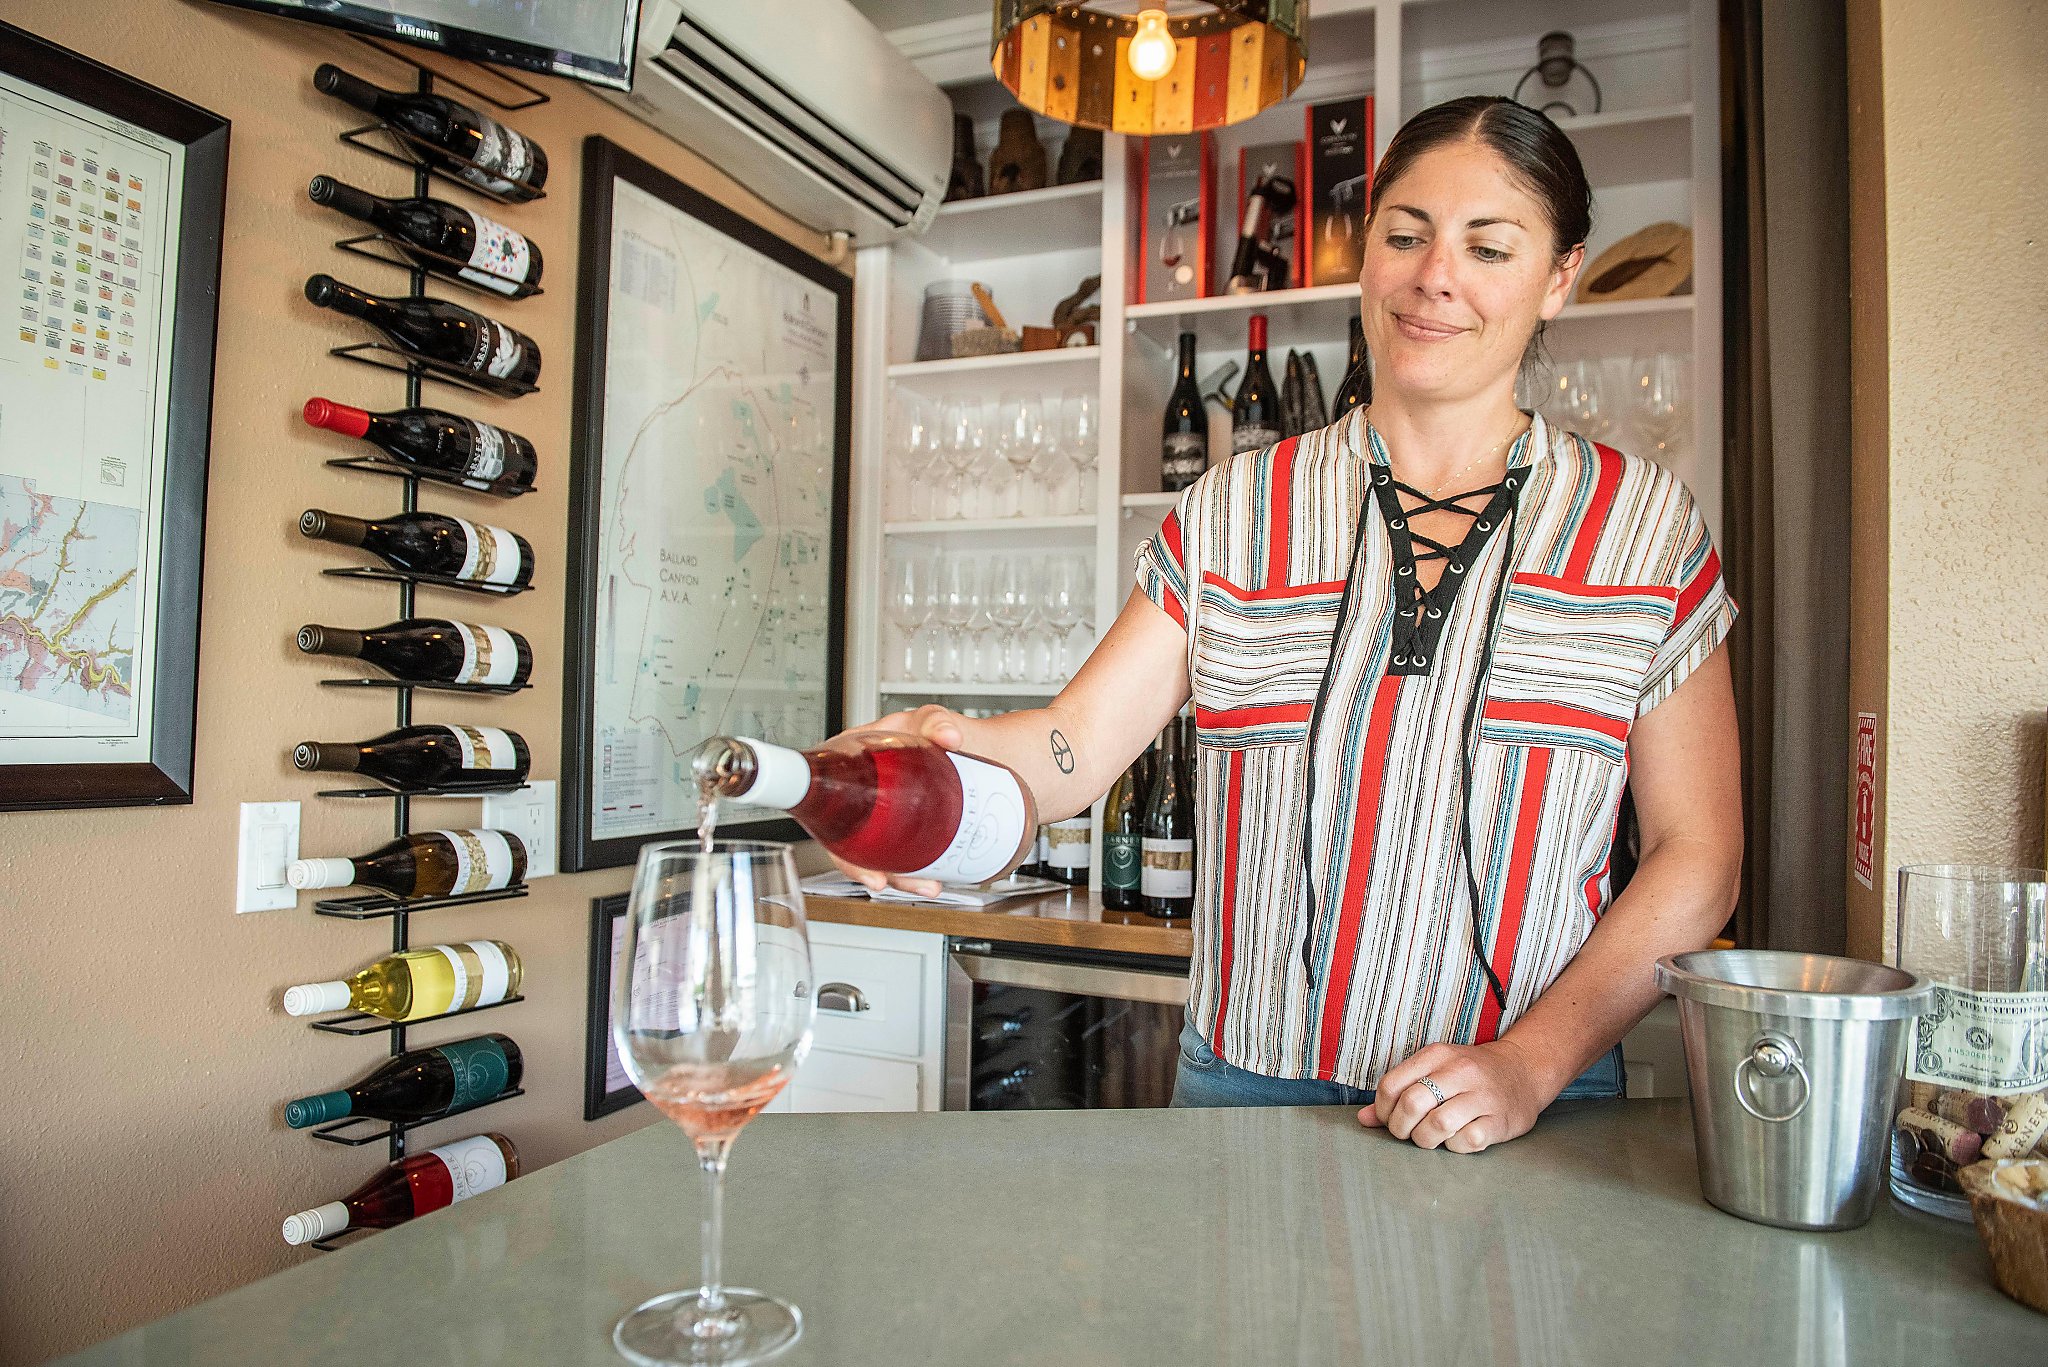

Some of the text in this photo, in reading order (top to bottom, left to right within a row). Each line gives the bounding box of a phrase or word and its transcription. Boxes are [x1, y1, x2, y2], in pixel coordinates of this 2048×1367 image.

[395, 23, 440, 42] SAMSUNG
[473, 326, 490, 372] ARNER
[466, 436, 483, 478] ARNER
[660, 549, 697, 567] BALLARD
[660, 568, 699, 586] CANYON
[1957, 999, 1981, 1013] THE
[1983, 1005, 2027, 1016] UNITED
[446, 1156, 464, 1198] ARNER
